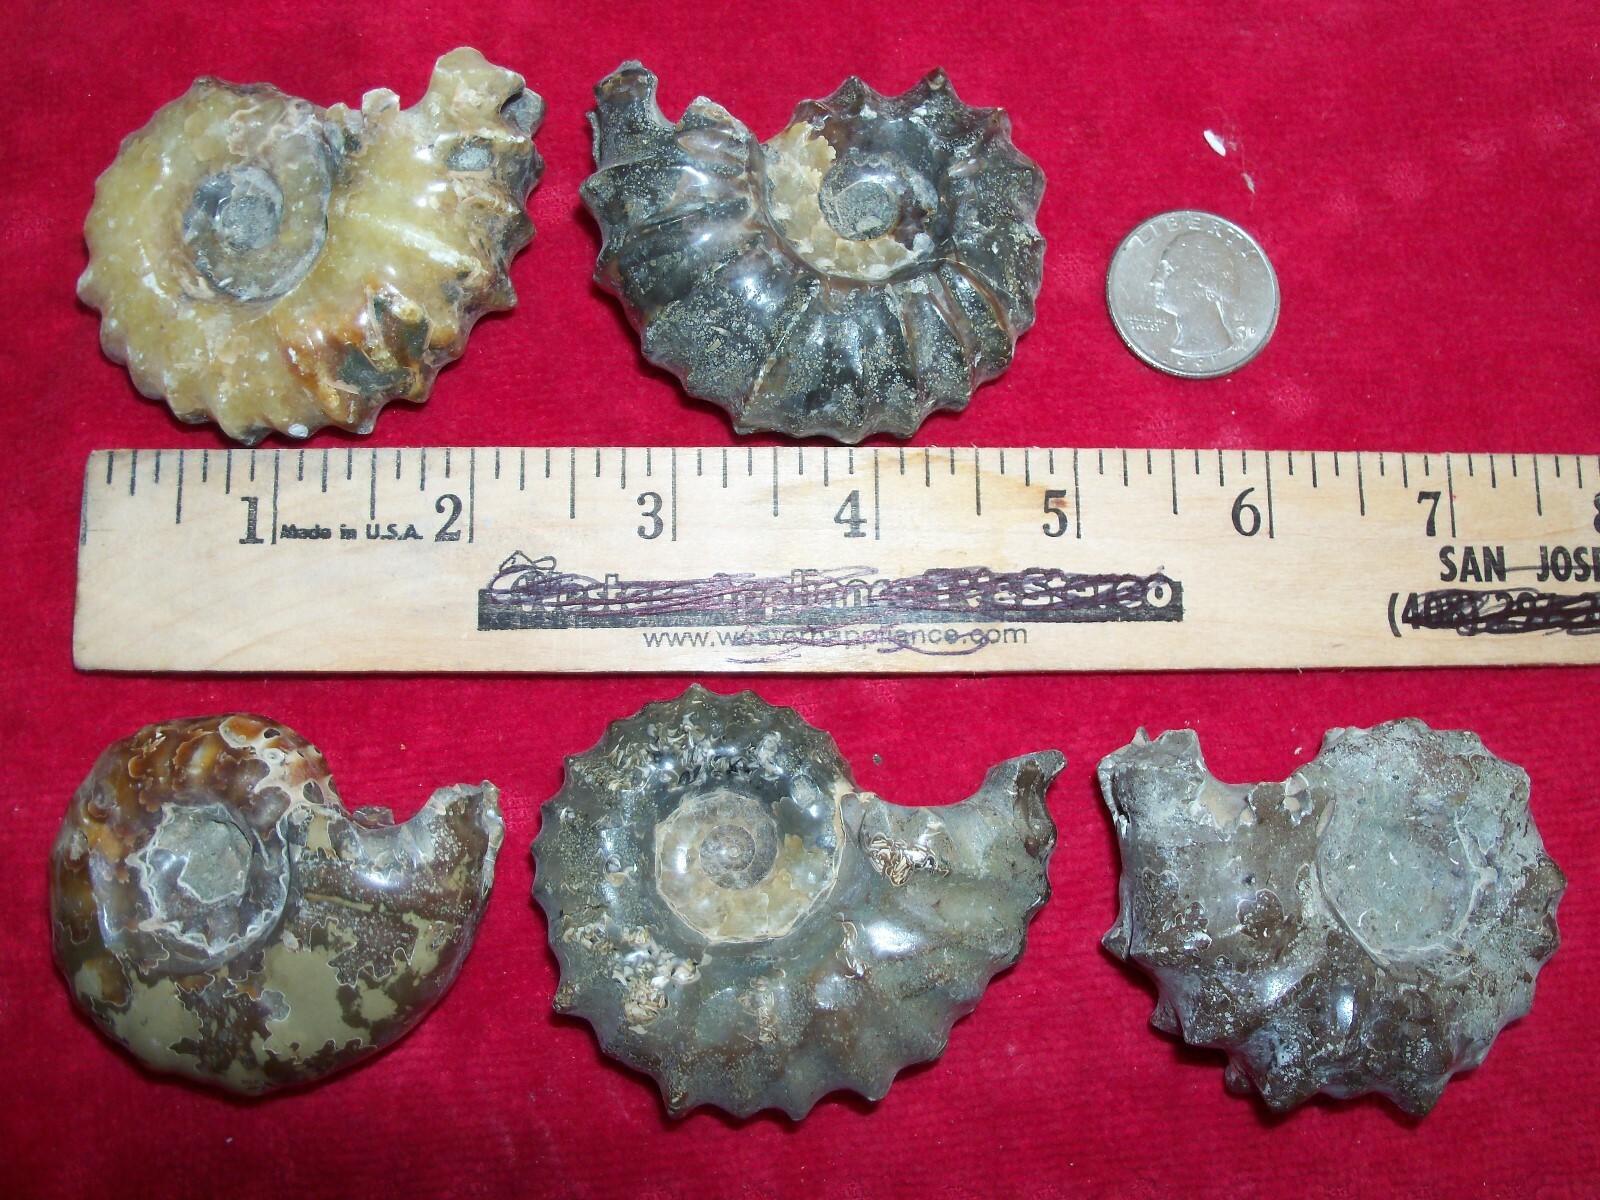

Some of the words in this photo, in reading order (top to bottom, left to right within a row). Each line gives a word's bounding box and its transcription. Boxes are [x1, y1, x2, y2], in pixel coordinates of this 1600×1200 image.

[1134, 216, 1258, 258] LIBERTY
[239, 496, 265, 545] 1
[280, 523, 332, 540] Made
[339, 523, 358, 540] in
[365, 523, 424, 541] U.S.A.
[434, 493, 463, 542] 2
[636, 491, 664, 540] 3
[833, 489, 867, 538] 4
[1042, 489, 1069, 538] 5
[1231, 487, 1262, 537] 6
[1416, 490, 1442, 537] 7
[1439, 545, 1507, 583] SAN
